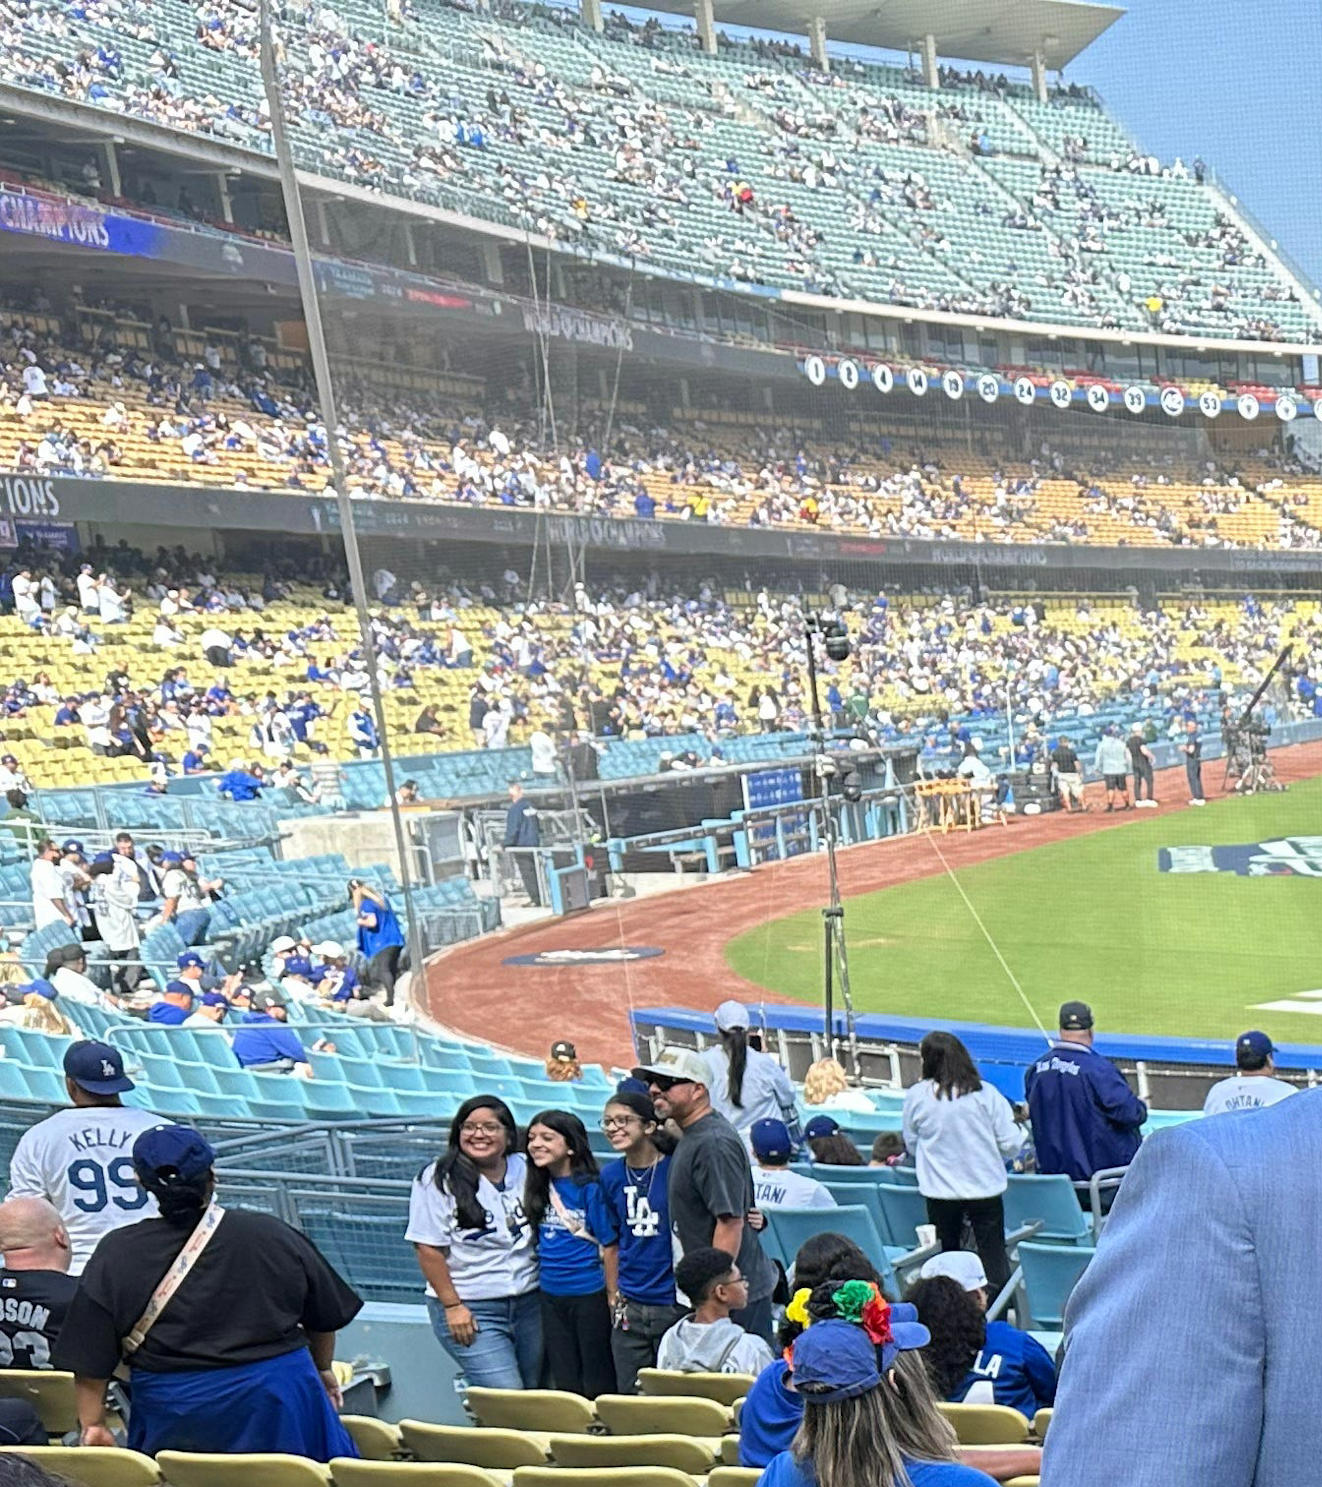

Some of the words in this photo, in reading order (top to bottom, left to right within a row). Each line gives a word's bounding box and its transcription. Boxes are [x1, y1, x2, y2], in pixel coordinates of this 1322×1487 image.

[0, 478, 60, 516] IONS
[100, 1058, 115, 1077] LA
[70, 1127, 133, 1152] KELLY
[69, 1156, 150, 1213] 99
[756, 1183, 787, 1204] TANI
[622, 1185, 661, 1237] LA
[0, 1297, 51, 1331] SON
[972, 1349, 1003, 1379] LA
